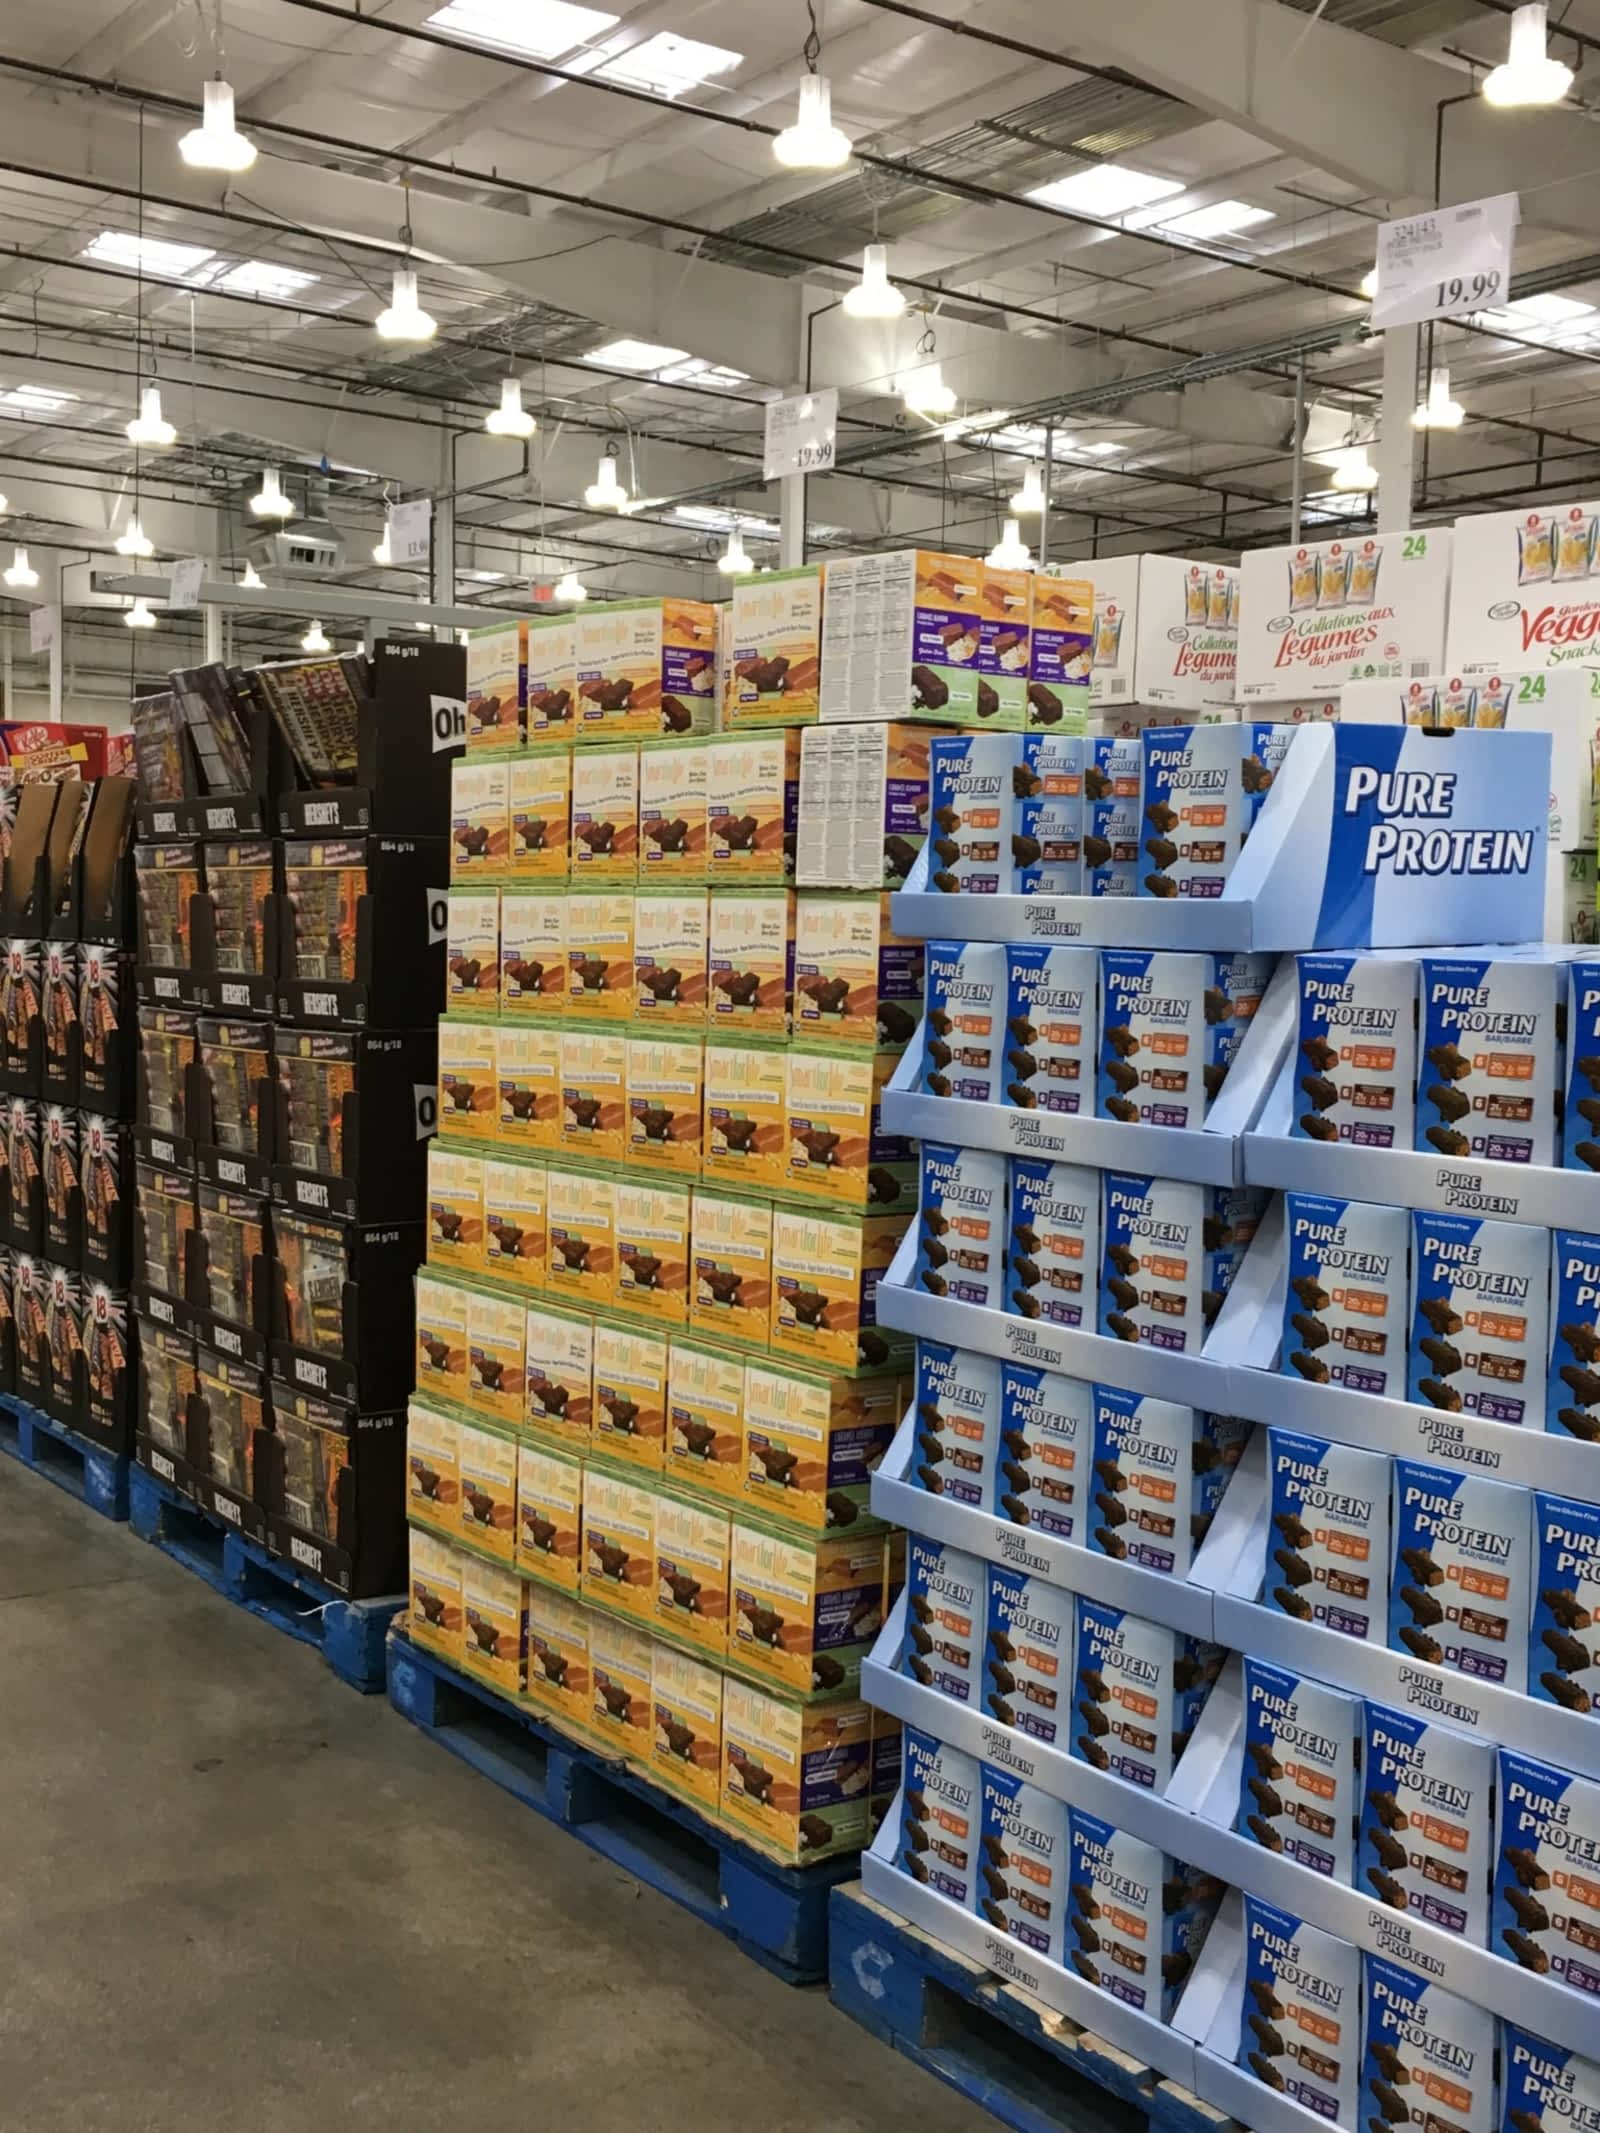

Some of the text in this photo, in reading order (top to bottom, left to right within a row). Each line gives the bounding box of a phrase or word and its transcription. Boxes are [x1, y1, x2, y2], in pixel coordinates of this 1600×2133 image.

[1436, 271, 1501, 308] 19.99
[1402, 535, 1427, 557] 24
[1299, 612, 1367, 637] Collations
[1367, 607, 1395, 621] aux
[1521, 606, 1600, 652] Vegg
[1192, 634, 1238, 651] Collation
[1309, 645, 1366, 668] du jardin
[1546, 639, 1600, 667] Snack
[1209, 669, 1235, 684] jardi
[1518, 673, 1546, 699] 24
[1028, 744, 1056, 755] PURE
[1100, 747, 1127, 759] PURE
[1258, 733, 1286, 747] PURE
[936, 758, 973, 774] PURE
[1033, 758, 1076, 769] PROTEIN
[1149, 750, 1194, 768] PURE
[942, 776, 1001, 794] PROTEIN
[1156, 770, 1229, 788] PROTEIN
[1344, 764, 1458, 818] PURE
[1027, 811, 1055, 823] PURE
[1032, 824, 1075, 836] PROTEIN
[1098, 812, 1126, 824] PURE
[1362, 823, 1534, 876] PROTEIN
[1570, 857, 1587, 878] 24
[1026, 878, 1054, 890] PURE
[1097, 878, 1125, 890] PURE
[1024, 905, 1056, 920] PURE
[1031, 921, 1082, 936] PROTEIN
[930, 960, 965, 979] PURE
[1011, 966, 1050, 985] PURE
[1109, 973, 1153, 993] PURE
[935, 980, 994, 1000] PROTEIN
[1017, 986, 1084, 1009] PROTEIN
[1304, 979, 1354, 1002] PURE
[1431, 983, 1490, 1007] PURE
[1116, 994, 1192, 1018] PROTEIN
[1312, 1003, 1397, 1028] PROTEIN
[1441, 1008, 1537, 1036] PROTEIN
[1009, 1115, 1041, 1133] PURE
[1015, 1130, 1065, 1151] PROTEIN
[926, 1159, 962, 1181] PURE
[1436, 1169, 1481, 1191] PURE
[931, 1179, 992, 1205] PROTEIN
[1016, 1174, 1054, 1196] PURE
[1021, 1194, 1086, 1223] PROTEIN
[1110, 1191, 1153, 1215] PURE
[1445, 1189, 1518, 1214] PROTEIN
[1117, 1213, 1190, 1243] PROTEIN
[1294, 1218, 1347, 1245] PURE
[1303, 1242, 1389, 1275] PROTEIN
[1423, 1237, 1481, 1265] PURE
[1432, 1263, 1529, 1298] PROTEIN
[1565, 1258, 1600, 1283] PU
[1005, 1324, 1037, 1343] PURE
[1011, 1340, 1062, 1364] PROTEIN
[922, 1355, 957, 1380] PURE
[927, 1375, 987, 1407] PROTEIN
[1005, 1379, 1044, 1405] PURE
[1011, 1401, 1077, 1435] PROTEIN
[1099, 1407, 1142, 1434] PURE
[1419, 1417, 1464, 1442] PURE
[1104, 1431, 1179, 1466] PROTEIN
[1427, 1437, 1500, 1468] PROTEIN
[1277, 1455, 1329, 1485] PURE
[1285, 1480, 1373, 1520] PROTEIN
[1405, 1486, 1463, 1519] PURE
[995, 1527, 1027, 1549] PURE
[1414, 1513, 1513, 1557] PROTEIN
[912, 1546, 945, 1574] PURE
[1001, 1545, 1051, 1573] PROTEIN
[917, 1567, 974, 1604] PROTEIN
[991, 1579, 1030, 1610] PURE
[997, 1601, 1061, 1642] PROTEIN
[1082, 1617, 1125, 1648] PURE
[1089, 1641, 1160, 1682] PROTEIN
[1399, 1665, 1443, 1695] PURE
[1251, 1684, 1298, 1721] PURE
[1407, 1686, 1480, 1725] PROTEIN
[982, 1725, 1011, 1751] PURE
[1258, 1712, 1338, 1761] PROTEIN
[1371, 1728, 1426, 1767] PURE
[908, 1741, 942, 1772] PURE
[987, 1743, 1035, 1776] PROTEIN
[913, 1763, 971, 1806] PROTEIN
[1379, 1755, 1472, 1811] PROTEIN
[985, 1783, 1022, 1818] PURE
[1508, 1781, 1571, 1825] PURE
[991, 1807, 1054, 1852] PROTEIN
[1518, 1811, 1600, 1863] PROTEI
[1073, 1831, 1113, 1866] PURE
[1080, 1856, 1149, 1905] PROTEIN
[1369, 1910, 1411, 1944] PURE
[985, 1935, 1015, 1963] PURE
[1251, 1921, 1301, 1964] PURE
[1376, 1933, 1446, 1977] PROTEIN
[1258, 1949, 1343, 2007] PROTEIN
[1373, 1981, 1429, 2026] PURE
[1381, 2010, 1475, 2072] PROTEIN
[1513, 2045, 1577, 2094] PURE
[1523, 2075, 1600, 2133] PROTE
